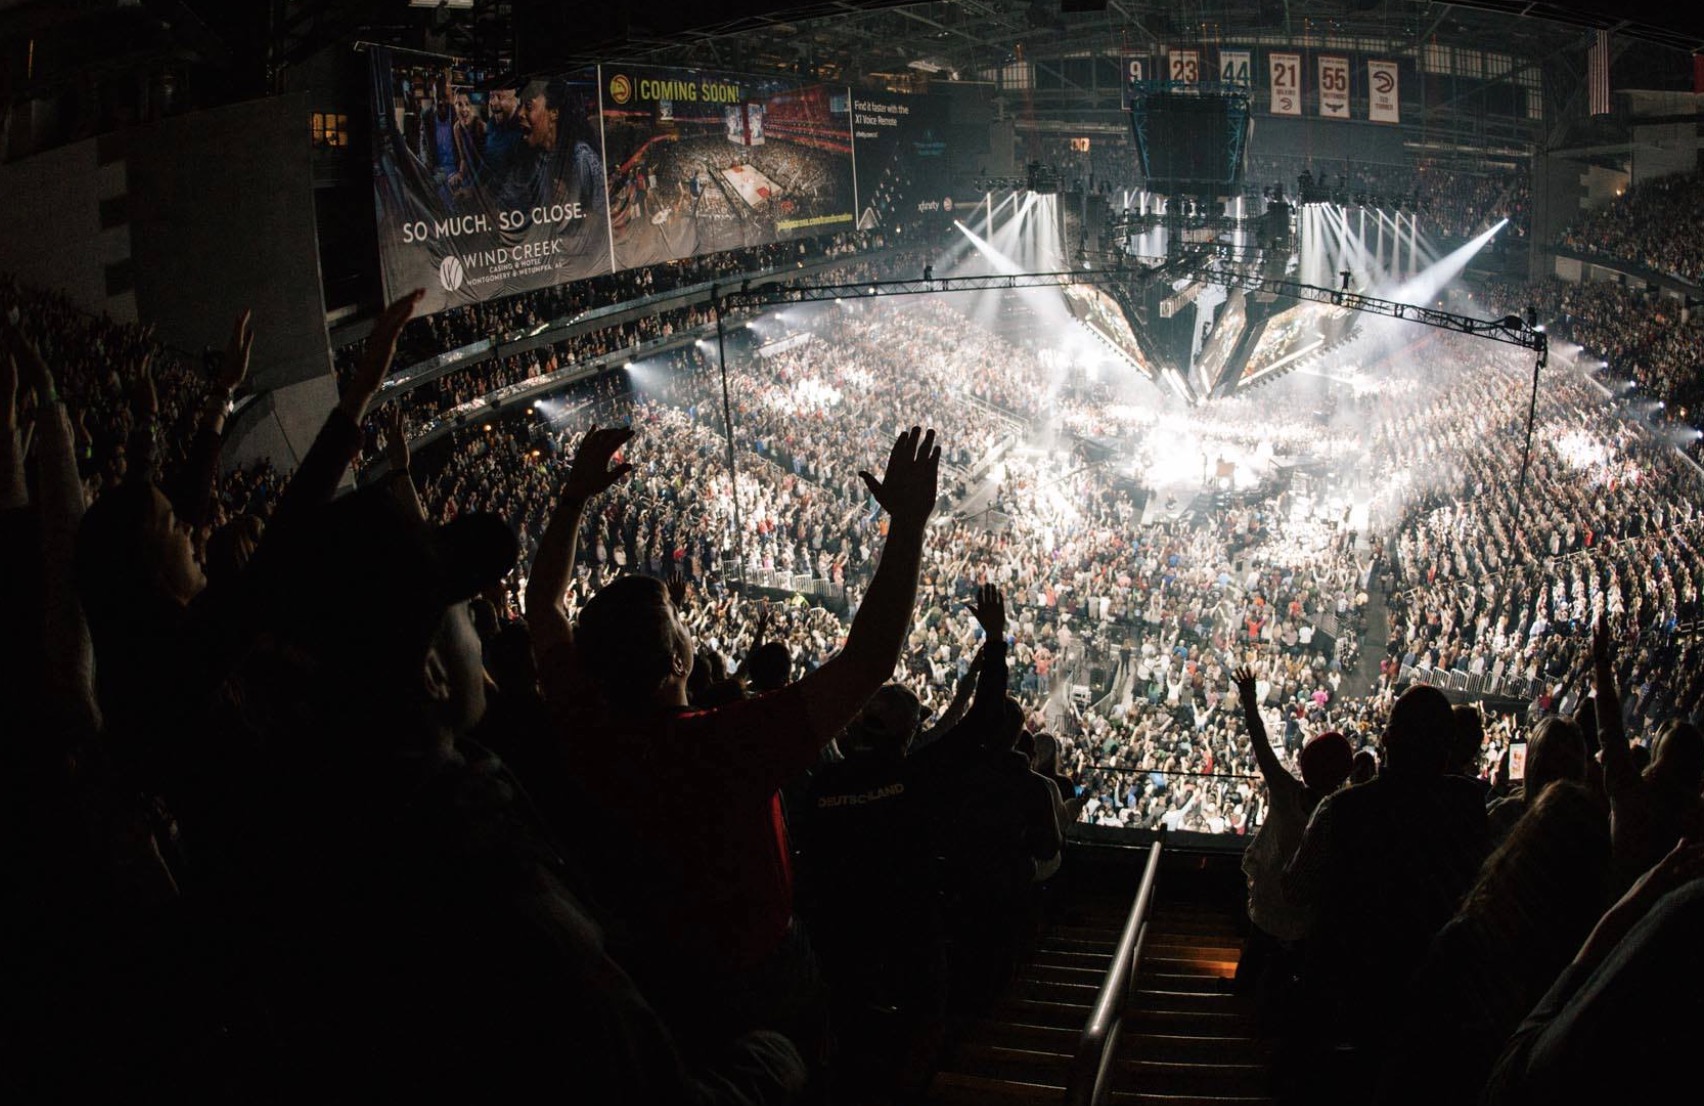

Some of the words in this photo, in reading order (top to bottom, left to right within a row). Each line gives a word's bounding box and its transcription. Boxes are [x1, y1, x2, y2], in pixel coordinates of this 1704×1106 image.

[1129, 60, 1142, 82] 9
[1173, 60, 1197, 83] 23
[1222, 60, 1248, 84] 44
[1274, 62, 1296, 88] 21
[1322, 66, 1346, 91] 55
[641, 79, 697, 101] COMING
[702, 83, 740, 103] SOON!
[854, 100, 866, 111] Find
[898, 104, 909, 115] the
[855, 114, 862, 124] X1
[863, 115, 877, 125] Voice
[878, 116, 897, 126] Remote
[403, 221, 428, 243] SO
[435, 214, 491, 239] MUCH.
[500, 210, 524, 229] SO
[532, 203, 586, 225] CLOSE.
[463, 249, 507, 269] WIND
[512, 241, 561, 262] CREEK
[489, 263, 513, 273] CASINO
[521, 258, 542, 267] HOTEL
[467, 272, 510, 286] MONTGOMERY
